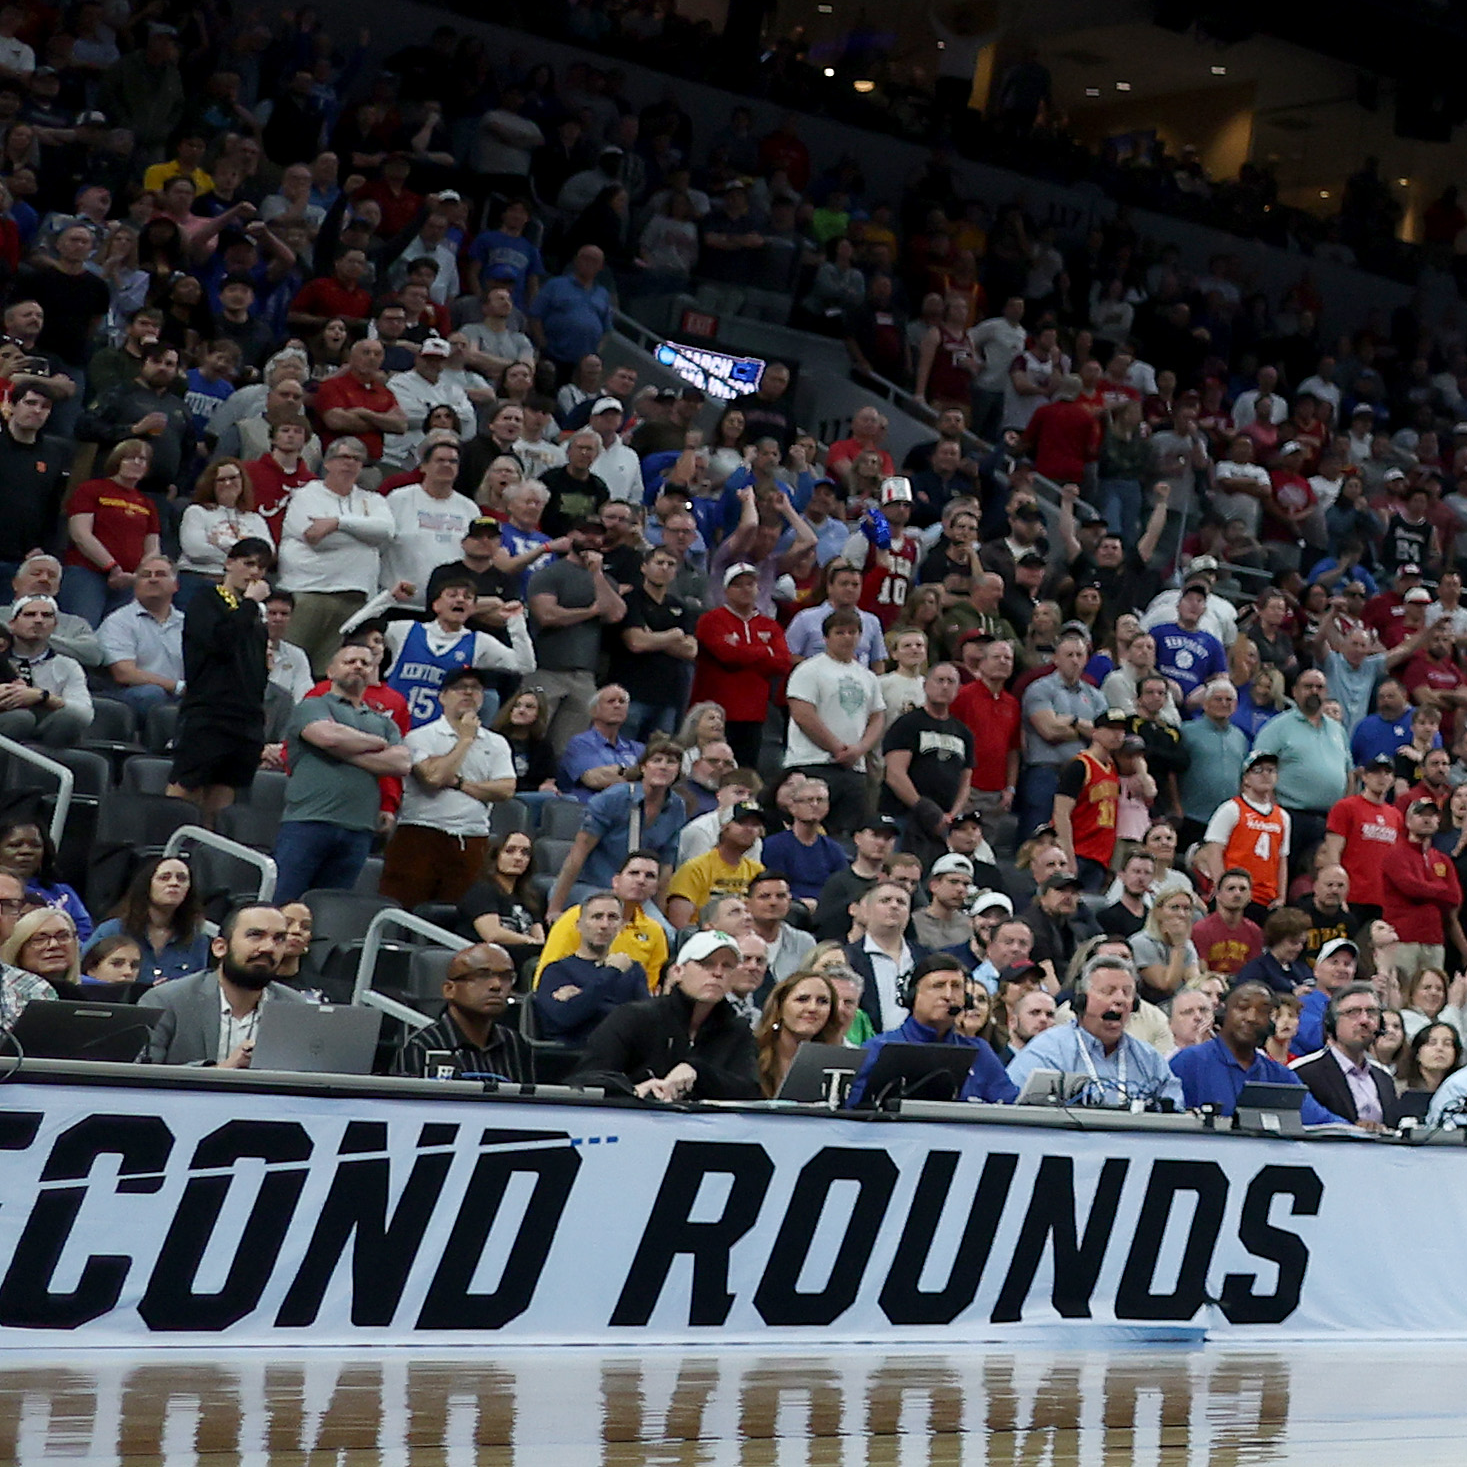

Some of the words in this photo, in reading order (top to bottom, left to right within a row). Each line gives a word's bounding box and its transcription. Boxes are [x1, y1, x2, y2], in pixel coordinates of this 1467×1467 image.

[408, 685, 437, 720] 15
[1253, 832, 1271, 862] 4
[0, 1111, 584, 1332] COND
[608, 1139, 1325, 1327] ROUNDS
